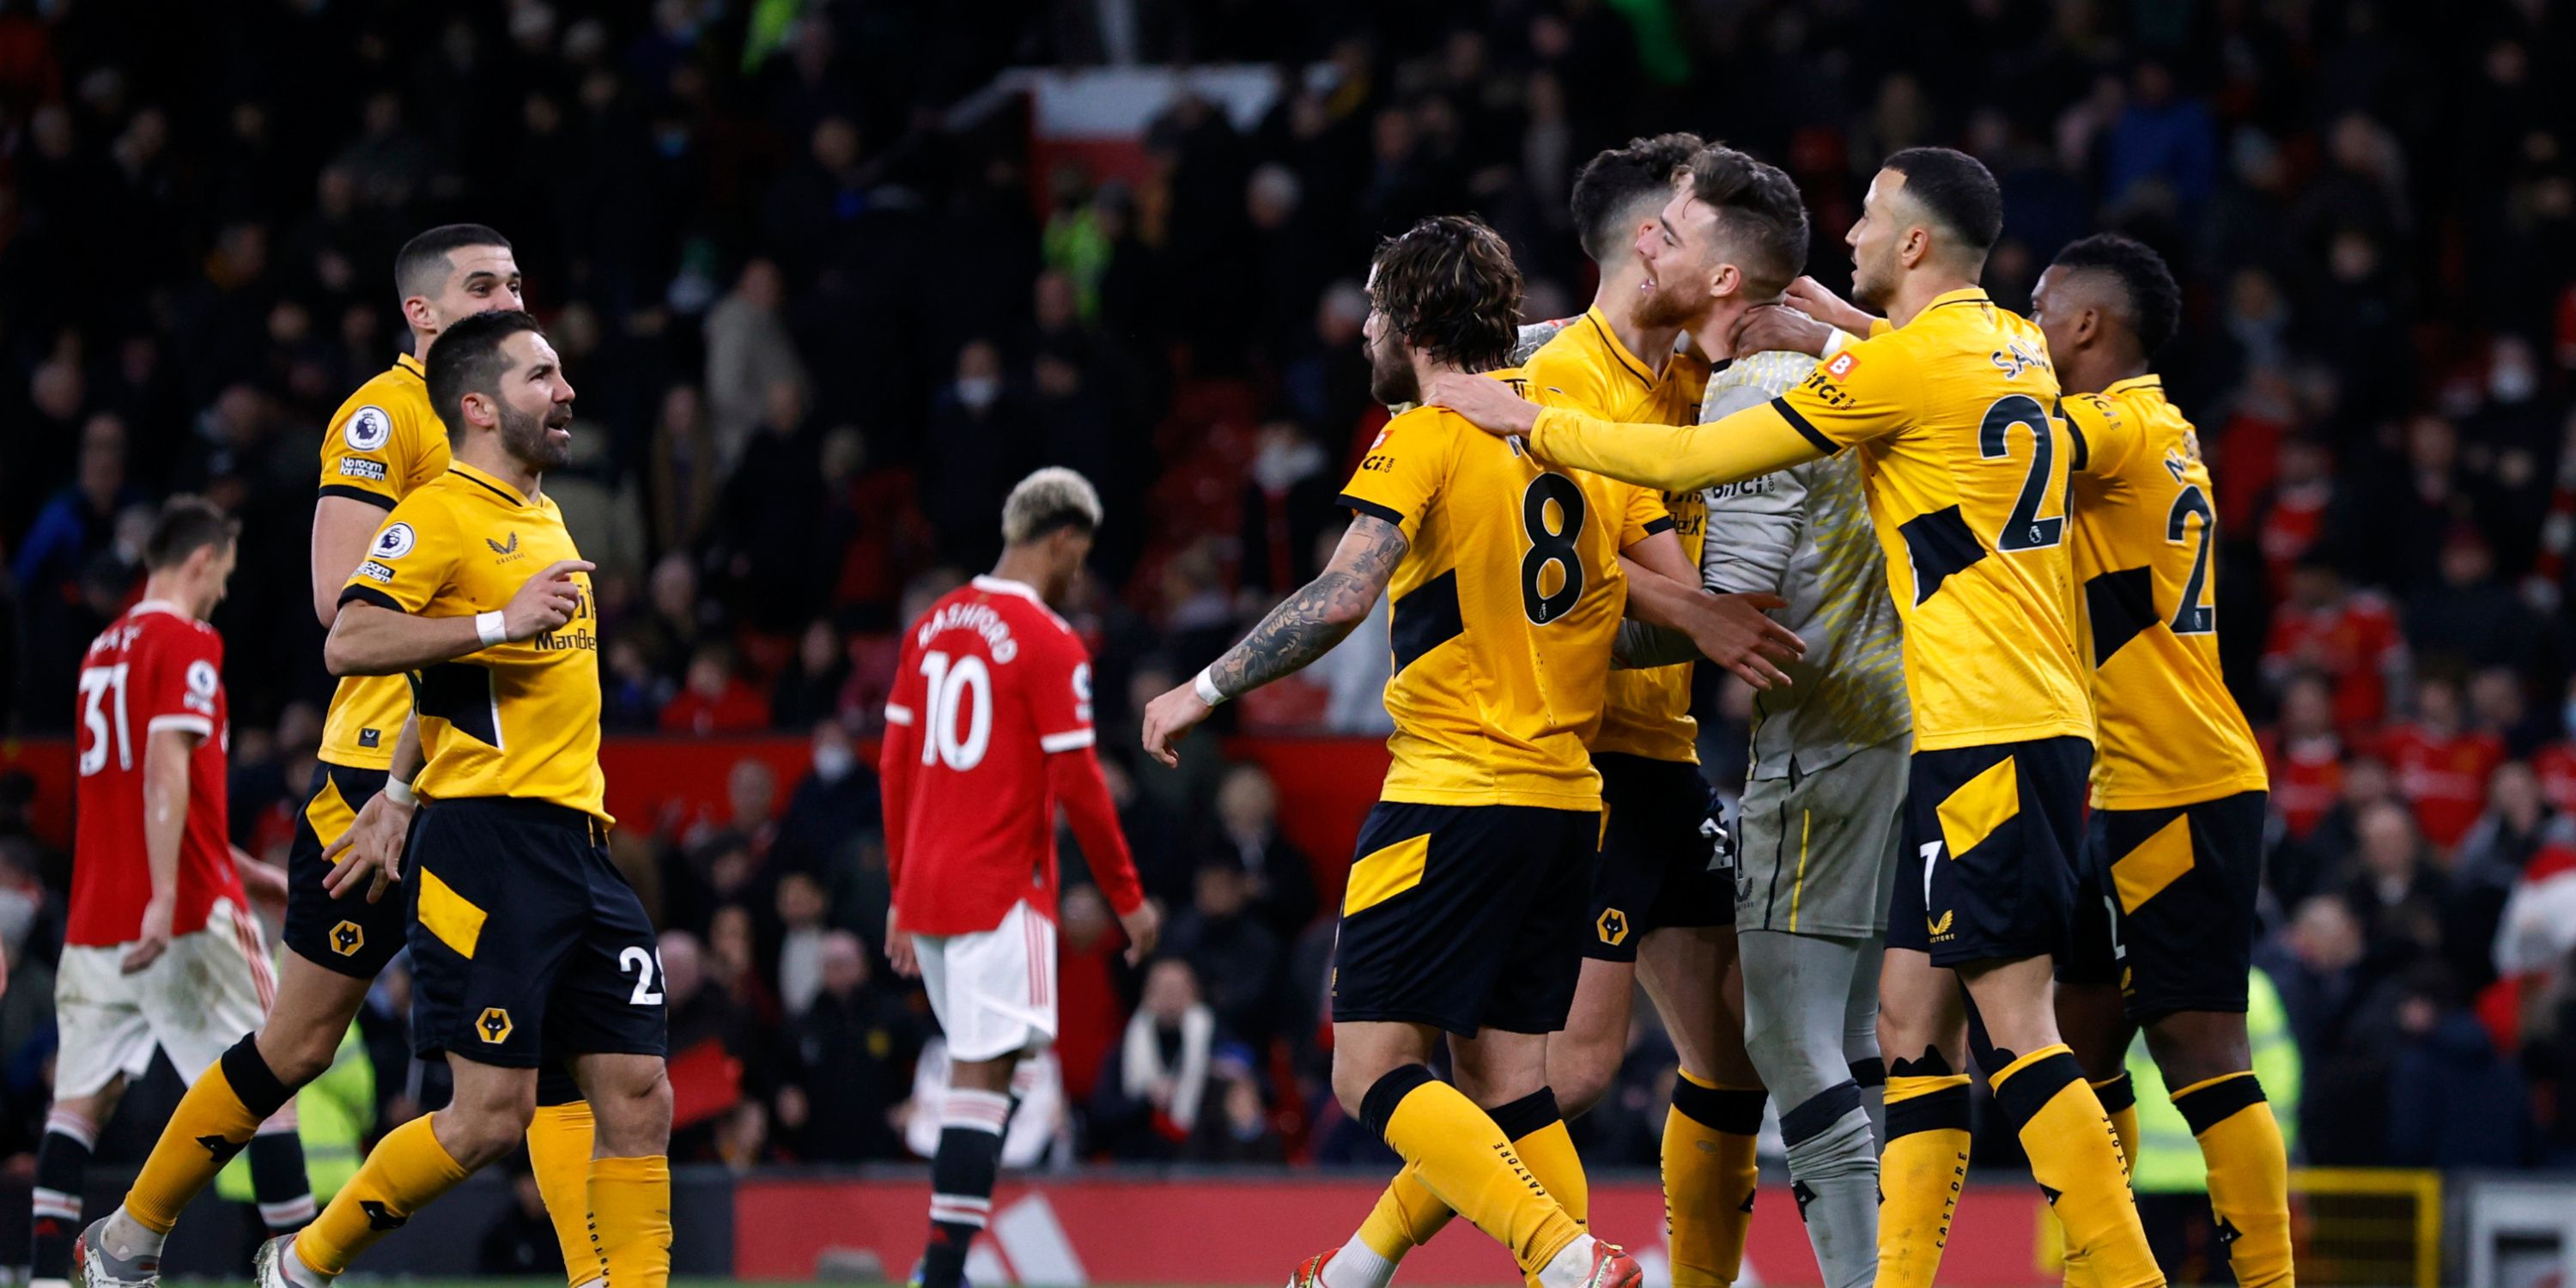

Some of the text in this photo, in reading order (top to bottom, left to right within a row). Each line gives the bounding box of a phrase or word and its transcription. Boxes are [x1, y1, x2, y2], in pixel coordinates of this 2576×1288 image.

[1804, 372, 1846, 404] itci
[1830, 355, 1852, 374] B
[341, 458, 383, 472] No room
[1522, 471, 1586, 627] 8
[918, 603, 1018, 665] RASHFORD
[79, 661, 133, 777] 31
[920, 650, 993, 770] 10
[619, 946, 666, 1005] 2
[1492, 1142, 1546, 1196] CASTORE
[1935, 1152, 1968, 1249] CASTORE
